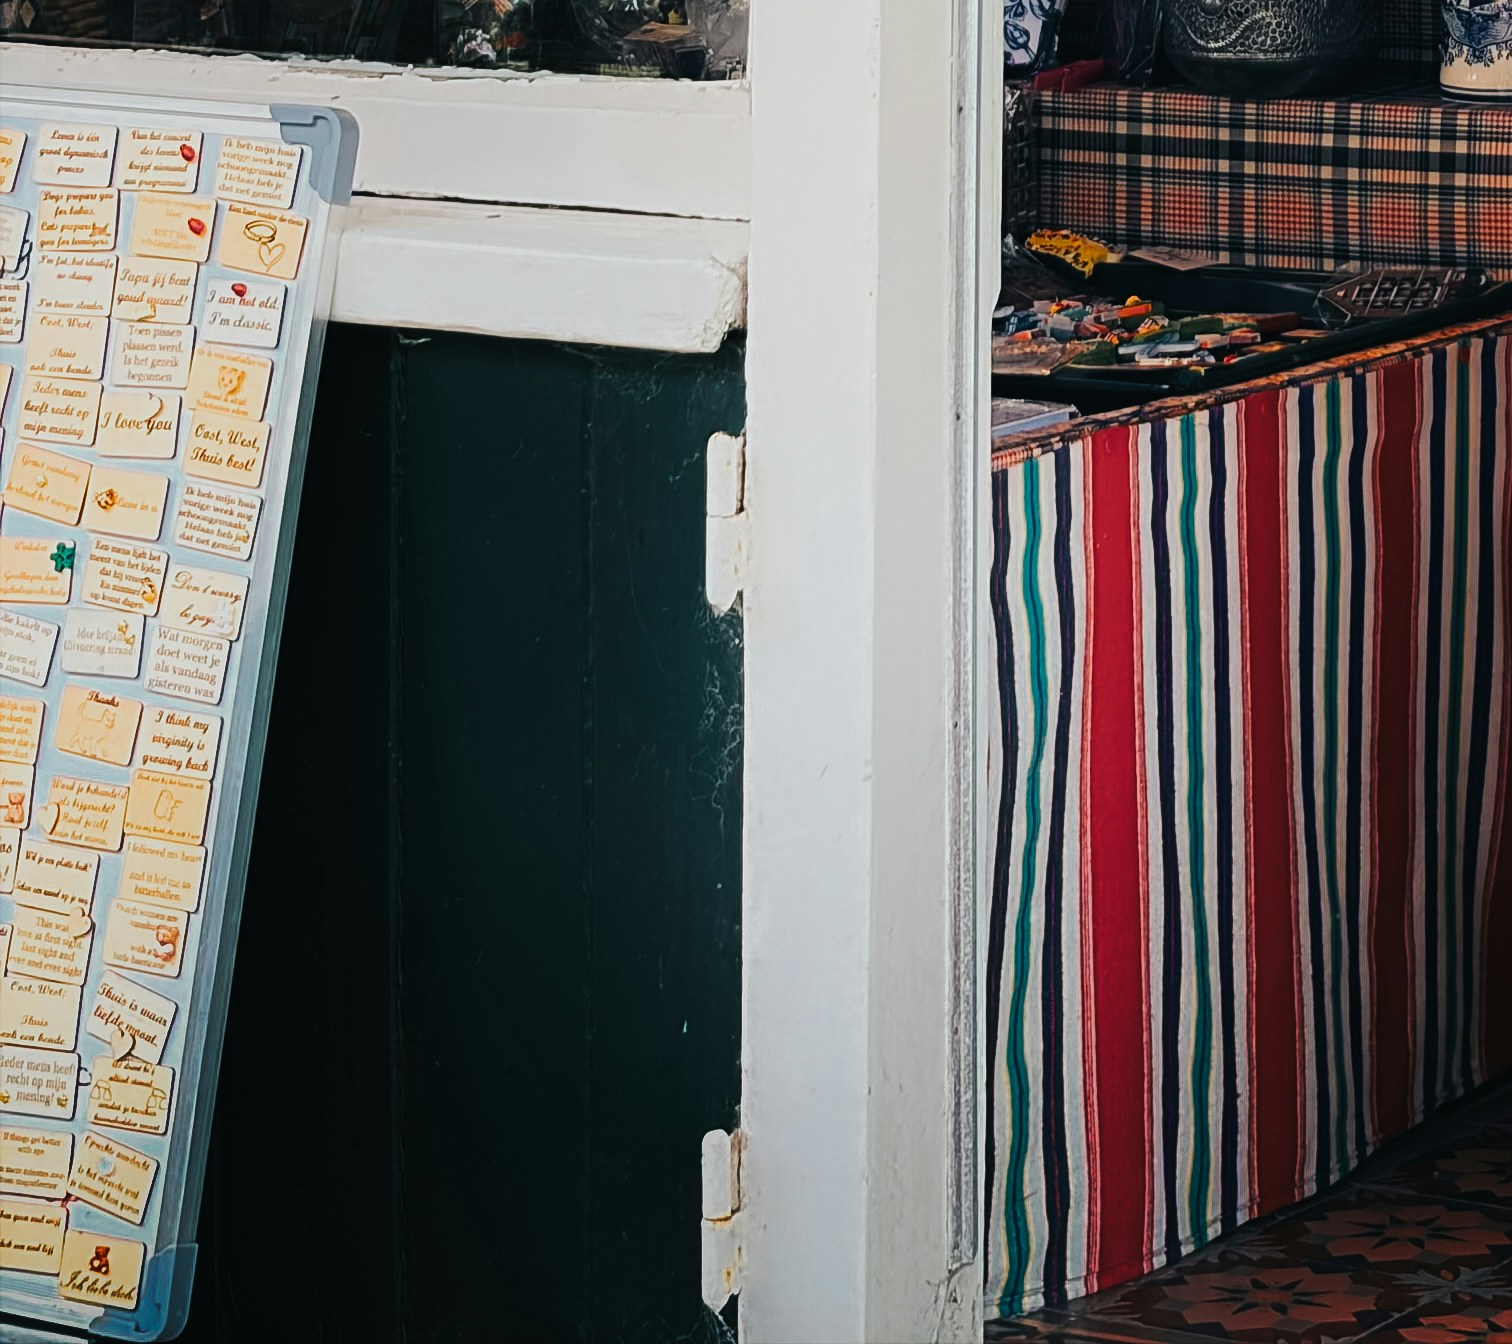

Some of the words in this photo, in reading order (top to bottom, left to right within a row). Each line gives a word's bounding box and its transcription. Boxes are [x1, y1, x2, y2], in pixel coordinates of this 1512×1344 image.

[218, 295, 235, 305] am
[101, 412, 112, 428] I
[114, 412, 140, 430] love
[145, 417, 174, 435] you
[194, 423, 224, 445] Oost,
[227, 429, 261, 453] West,
[190, 446, 224, 466] Thuis
[225, 452, 257, 472] best!
[158, 627, 179, 643] Wat
[181, 633, 224, 652] morgen
[156, 644, 181, 659] doet
[183, 649, 208, 662] weet
[209, 653, 221, 668] je
[153, 661, 170, 673] als
[171, 665, 217, 686] vandaag
[148, 677, 192, 695] gisteren
[194, 686, 215, 699] was
[154, 710, 164, 723] I
[165, 713, 191, 728] think
[192, 720, 210, 734] my
[196, 739, 206, 751] is
[142, 753, 184, 771] growing
[97, 982, 128, 1007] Thuis
[128, 999, 139, 1012] is
[93, 1004, 124, 1029] liefde
